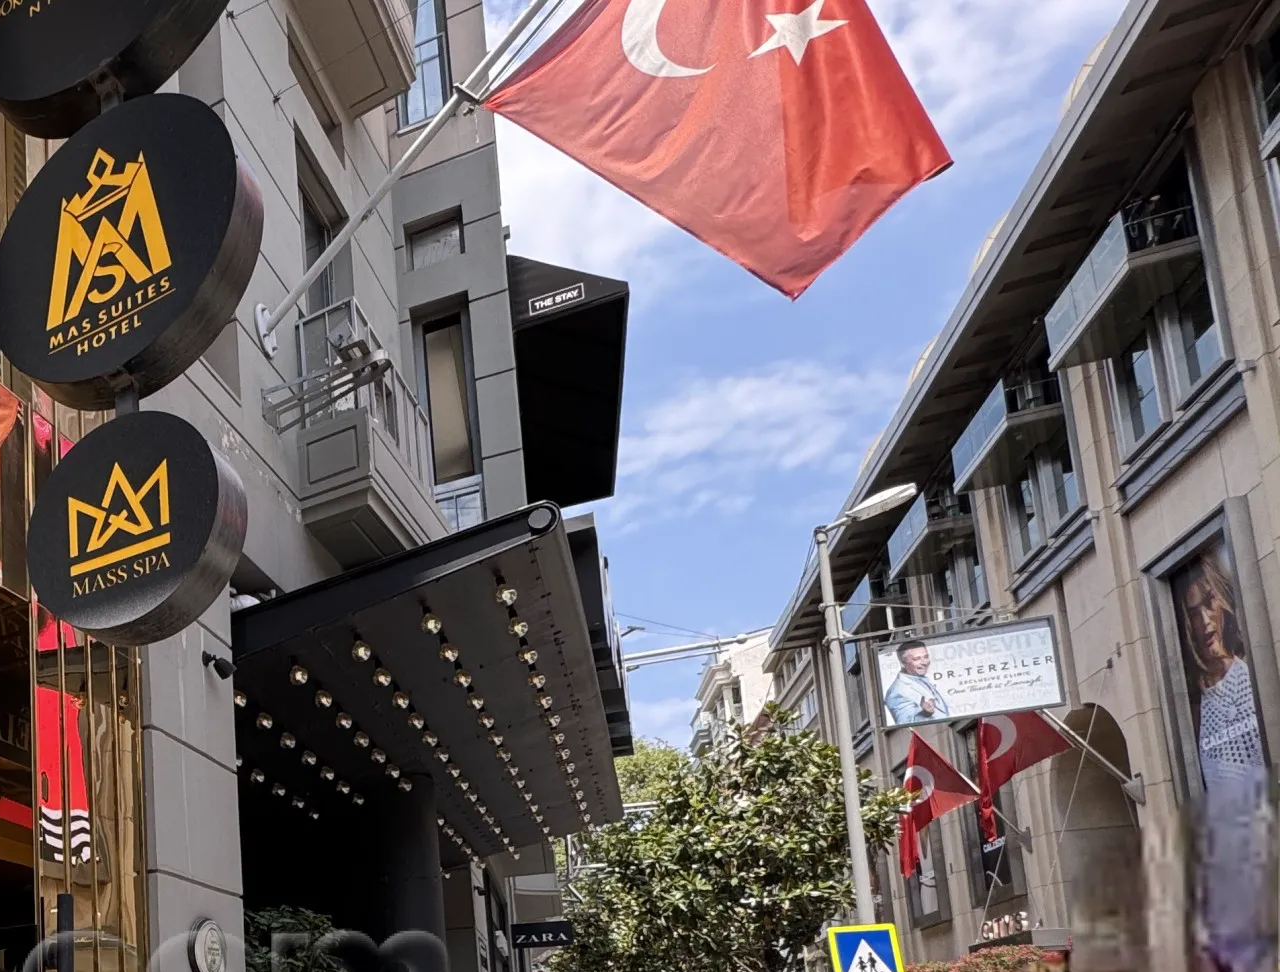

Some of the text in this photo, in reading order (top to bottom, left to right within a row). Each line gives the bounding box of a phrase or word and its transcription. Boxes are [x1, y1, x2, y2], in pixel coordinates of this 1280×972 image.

[49, 276, 171, 349] MAS SUITES
[534, 288, 579, 310] THE STAY
[77, 314, 142, 356] HOTEL
[72, 551, 171, 598] MASS SPA
[515, 932, 569, 944] ZARA
